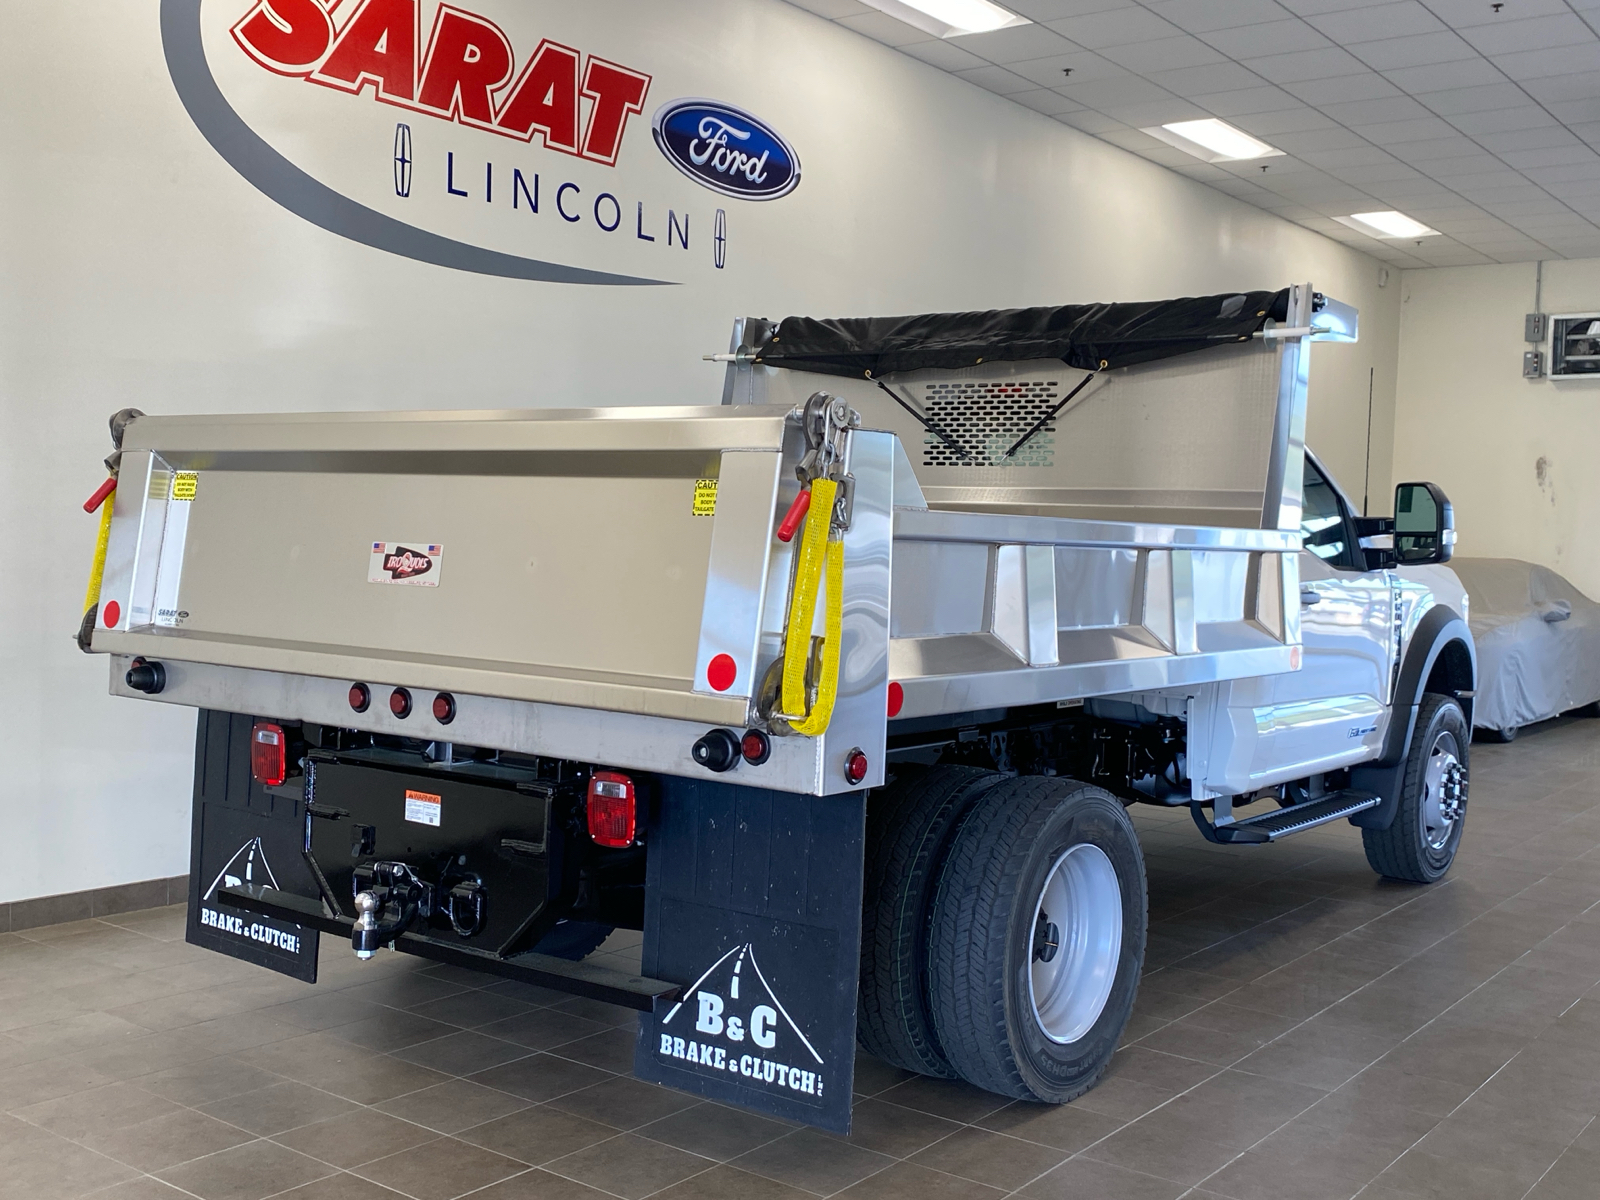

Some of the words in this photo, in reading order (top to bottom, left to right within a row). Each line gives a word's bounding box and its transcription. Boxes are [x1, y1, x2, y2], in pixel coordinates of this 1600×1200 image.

[230, 0, 652, 167] SARAT
[689, 116, 770, 184] Ford
[448, 151, 690, 251] LINCOLN
[414, 793, 439, 803] WARNING
[201, 907, 242, 935] BRAKE
[244, 926, 250, 937] &
[250, 923, 296, 952] CLUTCH
[660, 1033, 726, 1070] BRAKE
[728, 1057, 738, 1072] &
[739, 1054, 815, 1095] CLUTCH
